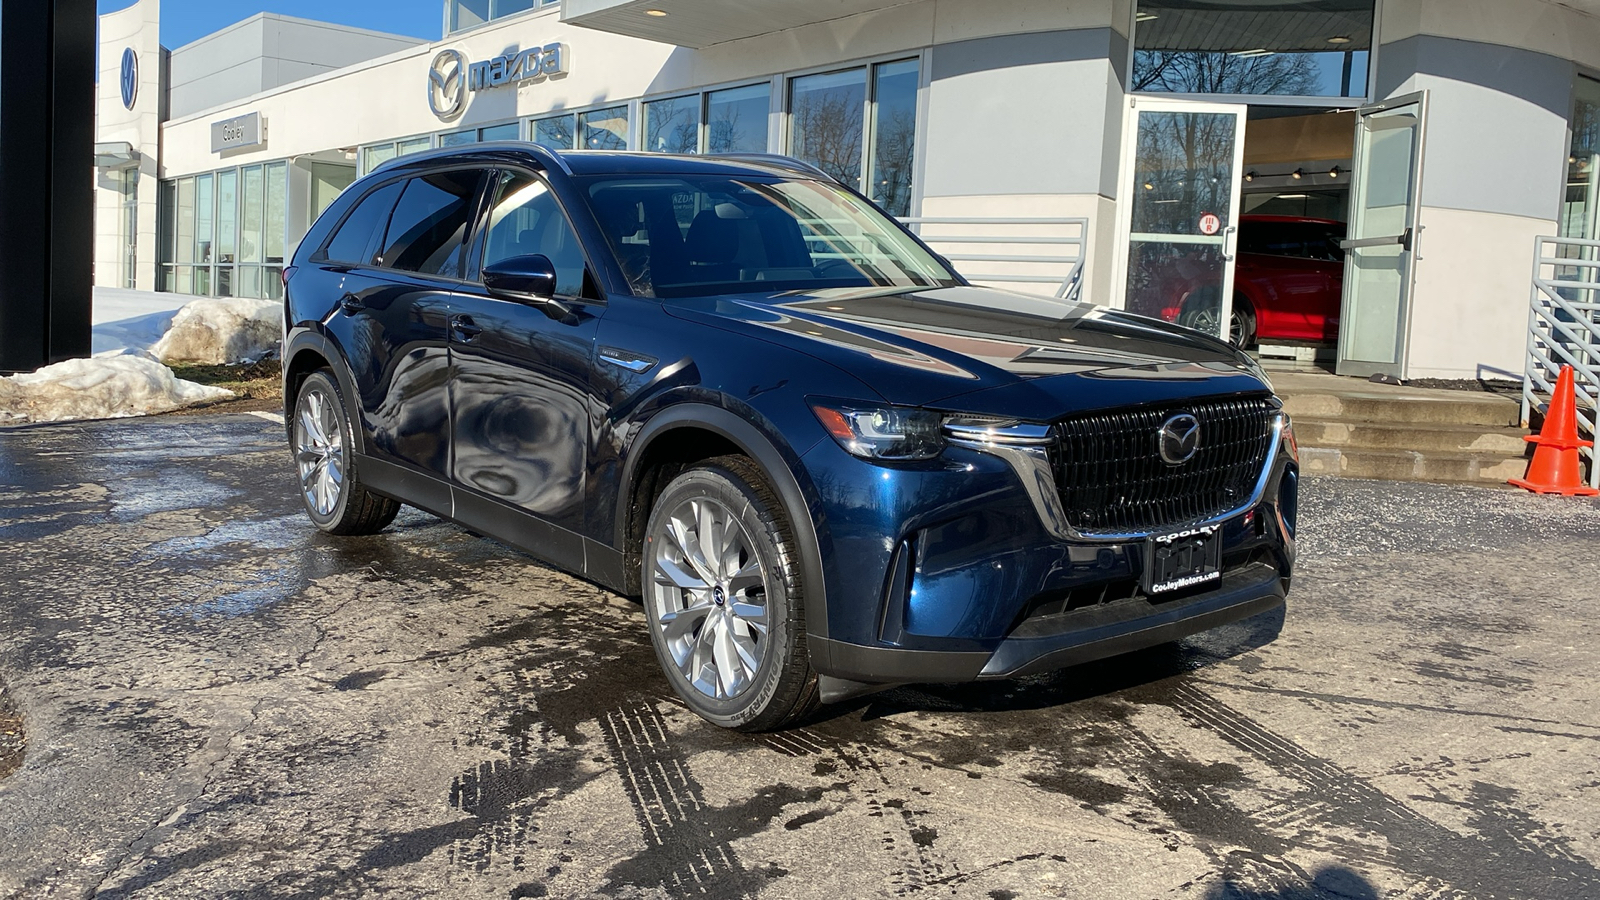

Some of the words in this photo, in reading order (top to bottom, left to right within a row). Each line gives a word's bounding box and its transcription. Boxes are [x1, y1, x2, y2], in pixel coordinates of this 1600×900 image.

[223, 120, 245, 144] Cooley
[673, 194, 694, 204] AZDA
[1156, 524, 1221, 543] COOLEY
[1152, 571, 1220, 593] CooleyMotors.com
